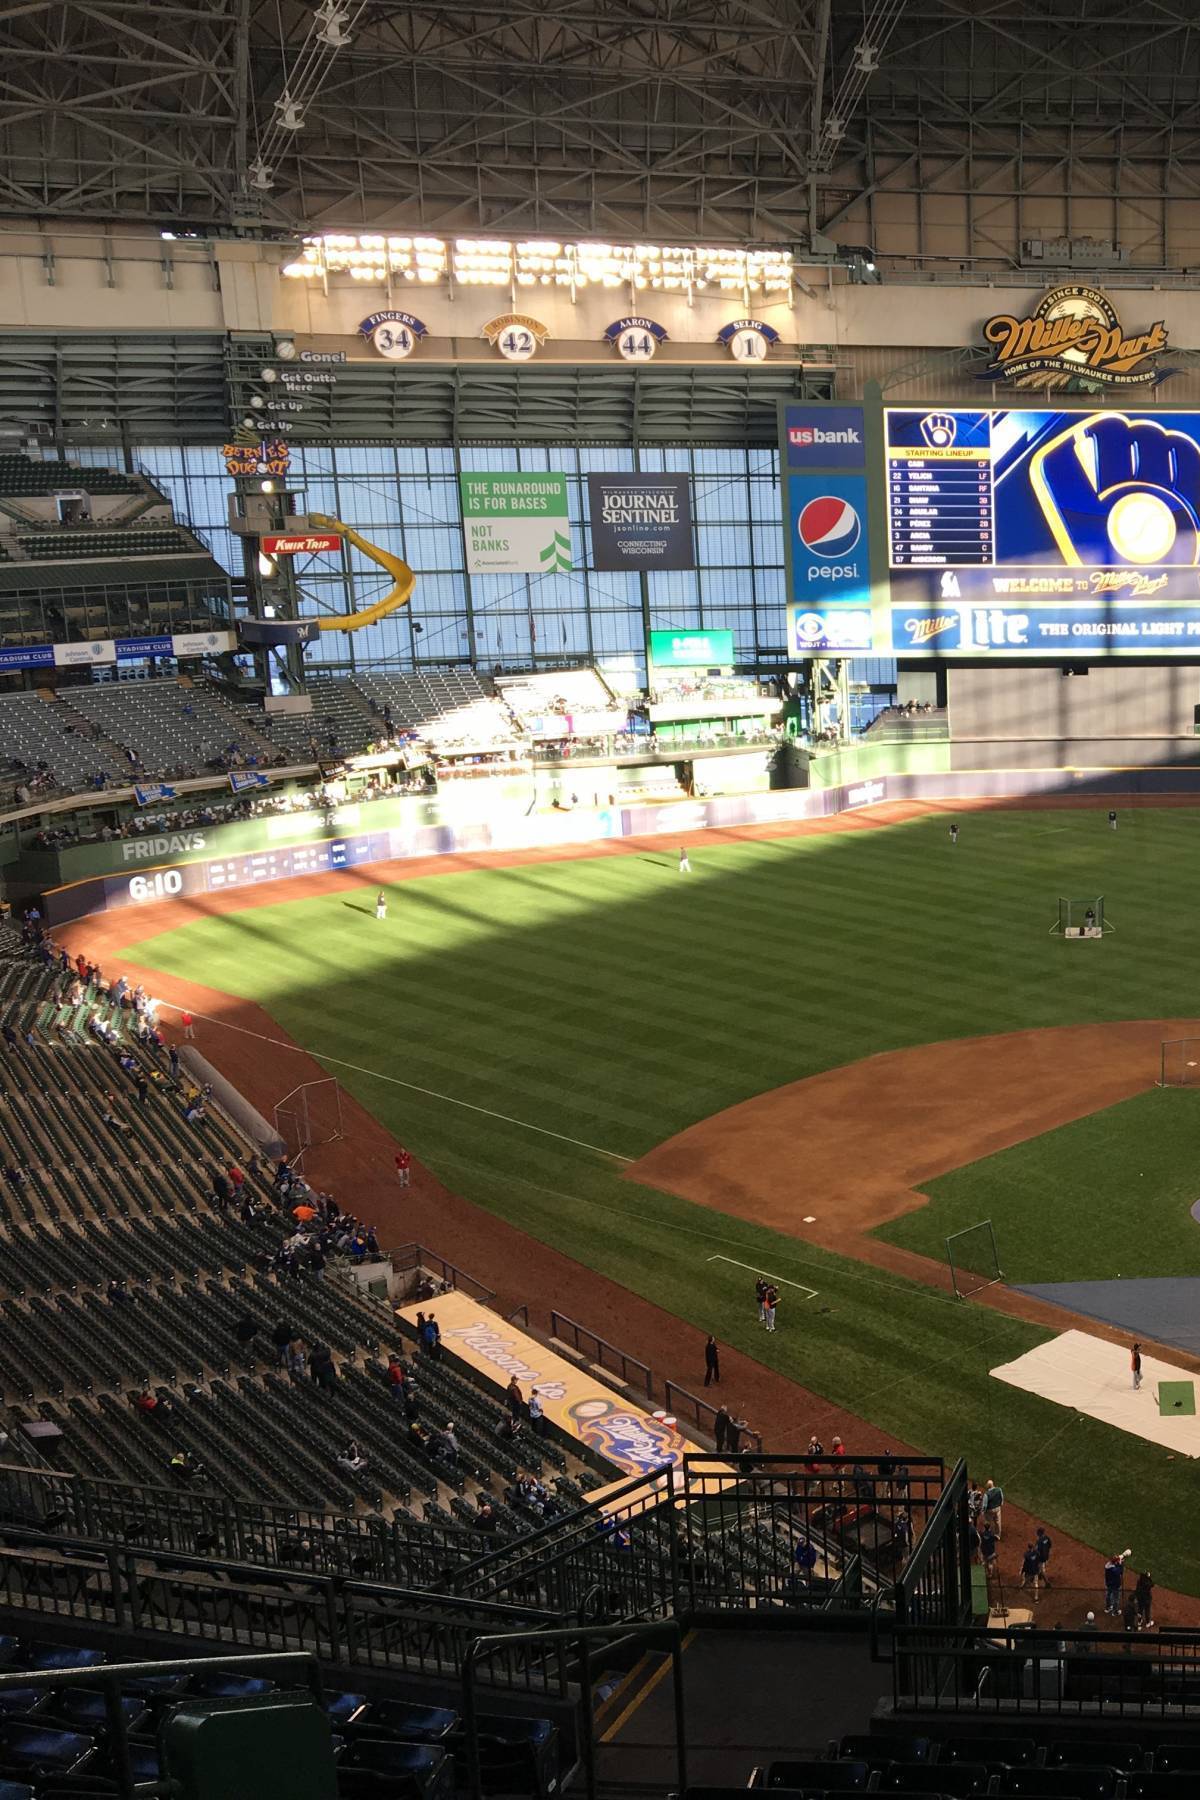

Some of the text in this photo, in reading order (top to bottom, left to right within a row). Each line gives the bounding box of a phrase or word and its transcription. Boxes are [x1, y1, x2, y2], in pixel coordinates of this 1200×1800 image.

[1049, 287, 1104, 305] SINCE 2001
[369, 312, 415, 326] FINGERS
[492, 315, 539, 330] ROBINSON
[619, 317, 652, 329] AARON
[733, 320, 763, 331] SELIG
[379, 329, 410, 351] 34
[502, 332, 533, 353] 42
[622, 334, 652, 355] 44
[986, 314, 1168, 371] Miller Park
[743, 337, 756, 358] 1
[300, 351, 346, 362] Gone!
[281, 373, 337, 383] Get Outta
[1003, 360, 1156, 383] HOME OF THE MILWAUKEE BREWERS
[286, 383, 313, 391] Here
[267, 402, 303, 412] Get Up
[256, 422, 293, 432] Get Up
[467, 482, 561, 495] THE RUNAROUND
[469, 497, 547, 510] IS FOR BASES
[602, 494, 679, 510] JOURNAL
[602, 510, 680, 524] SENTINEL
[471, 525, 493, 538] NOT
[613, 524, 671, 533] jsonline.com
[274, 538, 330, 551] KWIK TRIP
[472, 539, 510, 552] BANKS
[617, 540, 667, 548] CONNECTING
[621, 547, 664, 555] WISCONSIN
[807, 563, 858, 582] pepsi
[992, 577, 1089, 593] WELCOME TO
[904, 614, 959, 644] Miller
[956, 606, 1024, 650] Lite
[1039, 623, 1069, 636] THE
[1072, 622, 1140, 636] ORIGINAL
[1141, 622, 1184, 635] LIGHT
[117, 642, 172, 653] STADIUM CLUB
[32, 652, 53, 661] CLUB
[121, 832, 206, 861] FRIDAYS
[129, 869, 182, 900] 6:10
[445, 1322, 567, 1400] Welcome to
